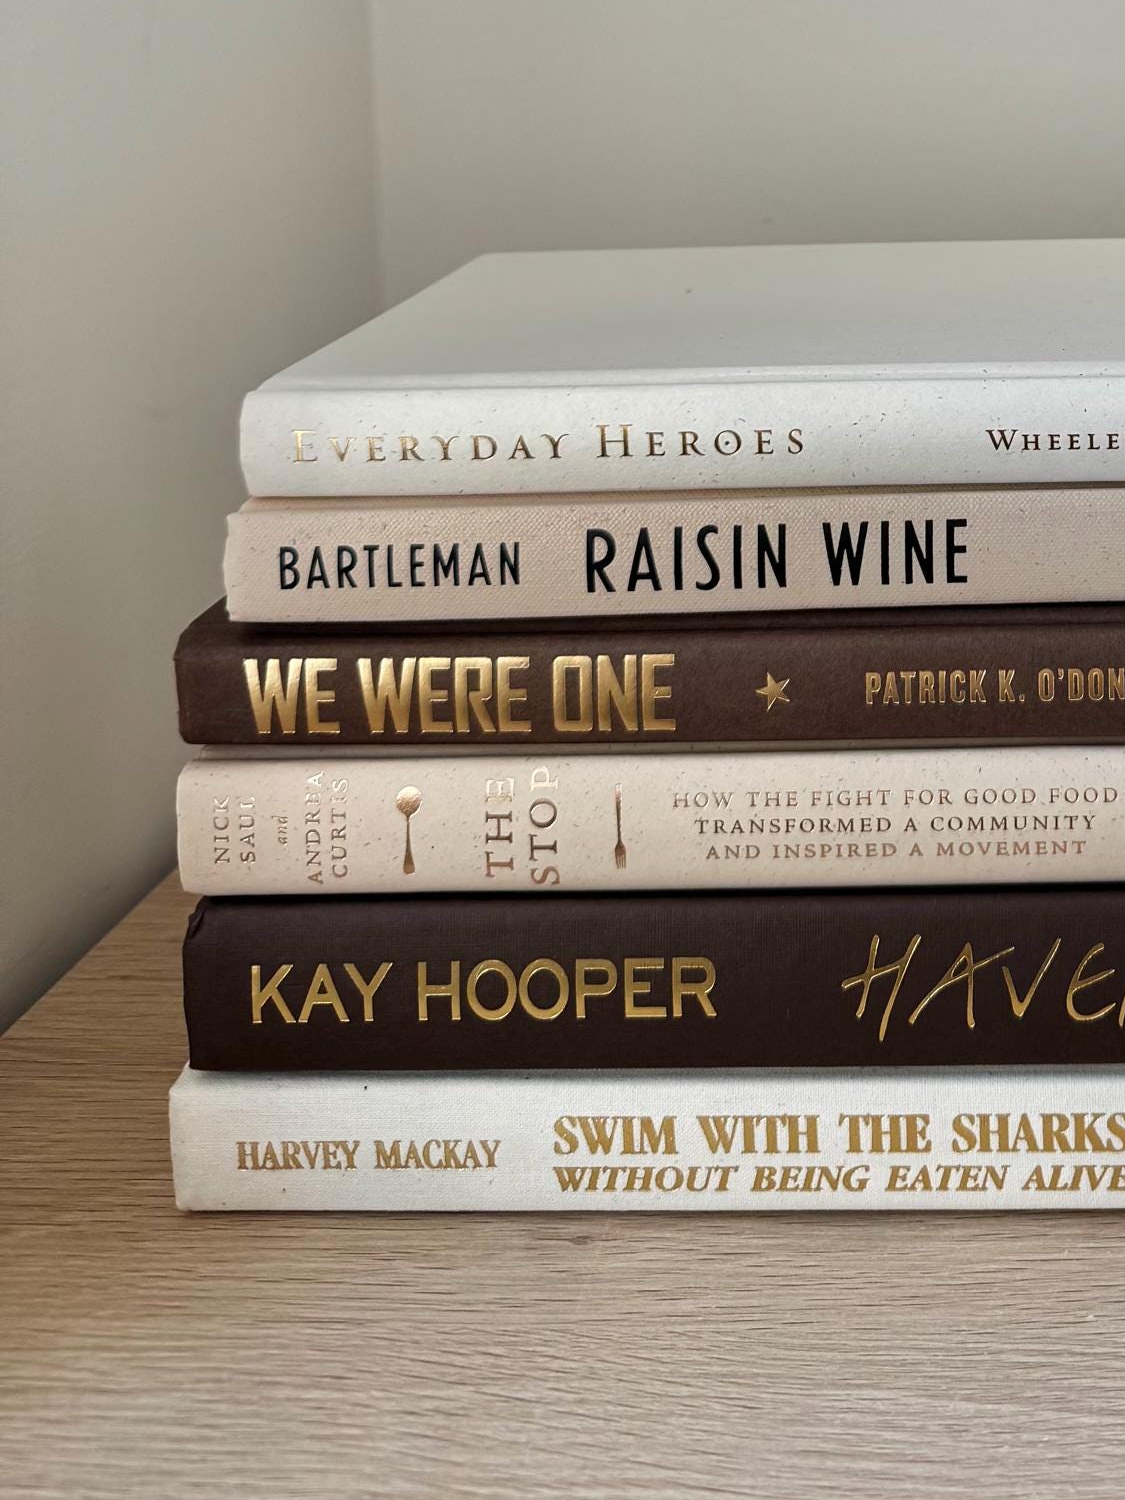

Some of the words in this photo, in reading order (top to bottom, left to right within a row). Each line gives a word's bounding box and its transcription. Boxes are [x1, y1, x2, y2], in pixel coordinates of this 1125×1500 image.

[278, 541, 521, 591] BARTLEMAN
[585, 522, 788, 593] RAISIN
[822, 518, 968, 586] WINE
[243, 657, 341, 734] WE
[357, 654, 532, 733] WERE
[551, 652, 677, 732] ONE
[865, 669, 987, 704] PATRICK
[998, 669, 1026, 703] K.
[213, 796, 230, 864] NICK
[239, 796, 256, 864] SAUL
[271, 815, 288, 846] and
[305, 770, 325, 885] ANDREA
[330, 779, 349, 878] CURTIS
[485, 777, 515, 878] THE
[528, 765, 560, 885] STOP
[672, 790, 734, 809] HOW
[746, 790, 799, 808] THE
[810, 788, 893, 807] FIGHT
[903, 788, 954, 806] FOR
[963, 787, 1038, 806] GOOD
[1048, 786, 1119, 805] FOOD
[694, 816, 893, 835] TRANSFORMED
[903, 817, 919, 832] A
[930, 813, 1097, 832] COMMUNITY
[705, 843, 762, 860] AND
[771, 841, 898, 860] INSPIRED
[908, 841, 924, 857] A
[935, 839, 1088, 858] MOVEMENT
[251, 962, 393, 1024] KAY
[416, 956, 718, 1022] HOOPER
[236, 1139, 360, 1171] HARVEY
[375, 1139, 501, 1169] MACKAY
[552, 1114, 678, 1156] SWIM
[696, 1114, 821, 1155] WITH
[838, 1113, 933, 1154] THE
[554, 1164, 739, 1193] WITHOUT
[751, 1164, 870, 1192] BEING
[885, 1164, 1010, 1192] EATEN
